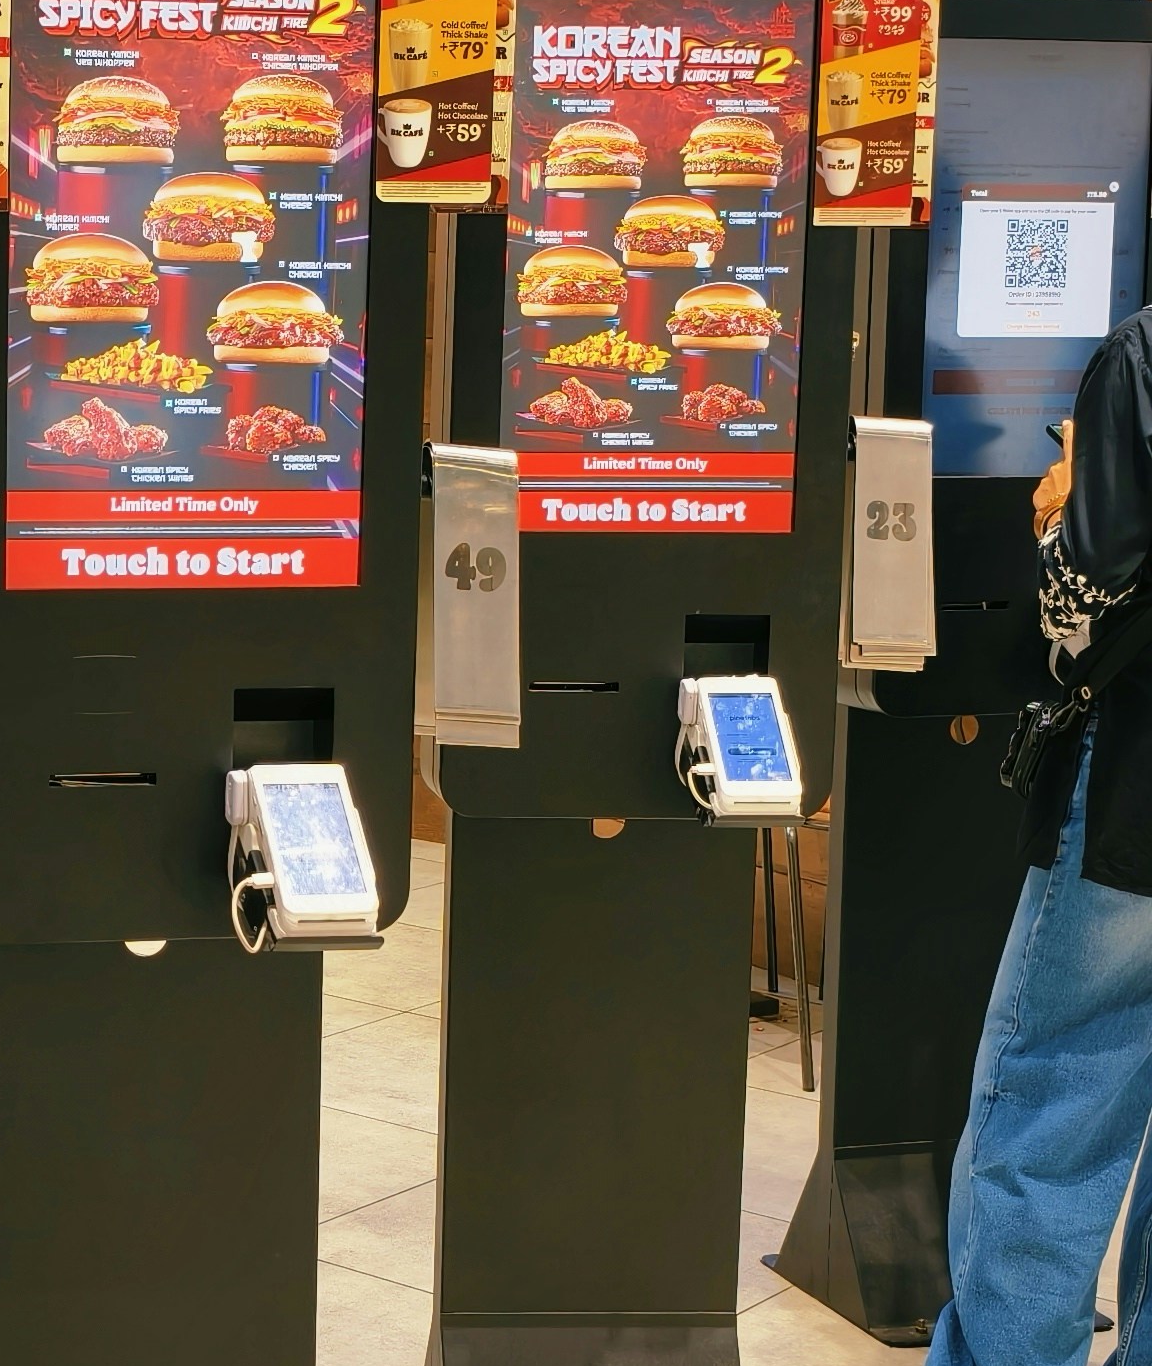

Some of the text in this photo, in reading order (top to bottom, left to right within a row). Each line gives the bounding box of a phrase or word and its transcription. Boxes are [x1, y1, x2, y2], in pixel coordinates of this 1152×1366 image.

[140, 1, 219, 32] FEST
[221, 15, 308, 32] KIMCHI FIRE
[533, 25, 681, 58] KOREAN
[688, 48, 761, 65] SEASON
[533, 58, 680, 85] SPICY FEST
[584, 457, 708, 472] Limited Time Only
[110, 497, 259, 514] Limited Time Only
[541, 497, 747, 522] Touch to Start
[865, 499, 917, 543] 23
[61, 547, 305, 576] Touch to Start
[444, 542, 508, 594] 49
